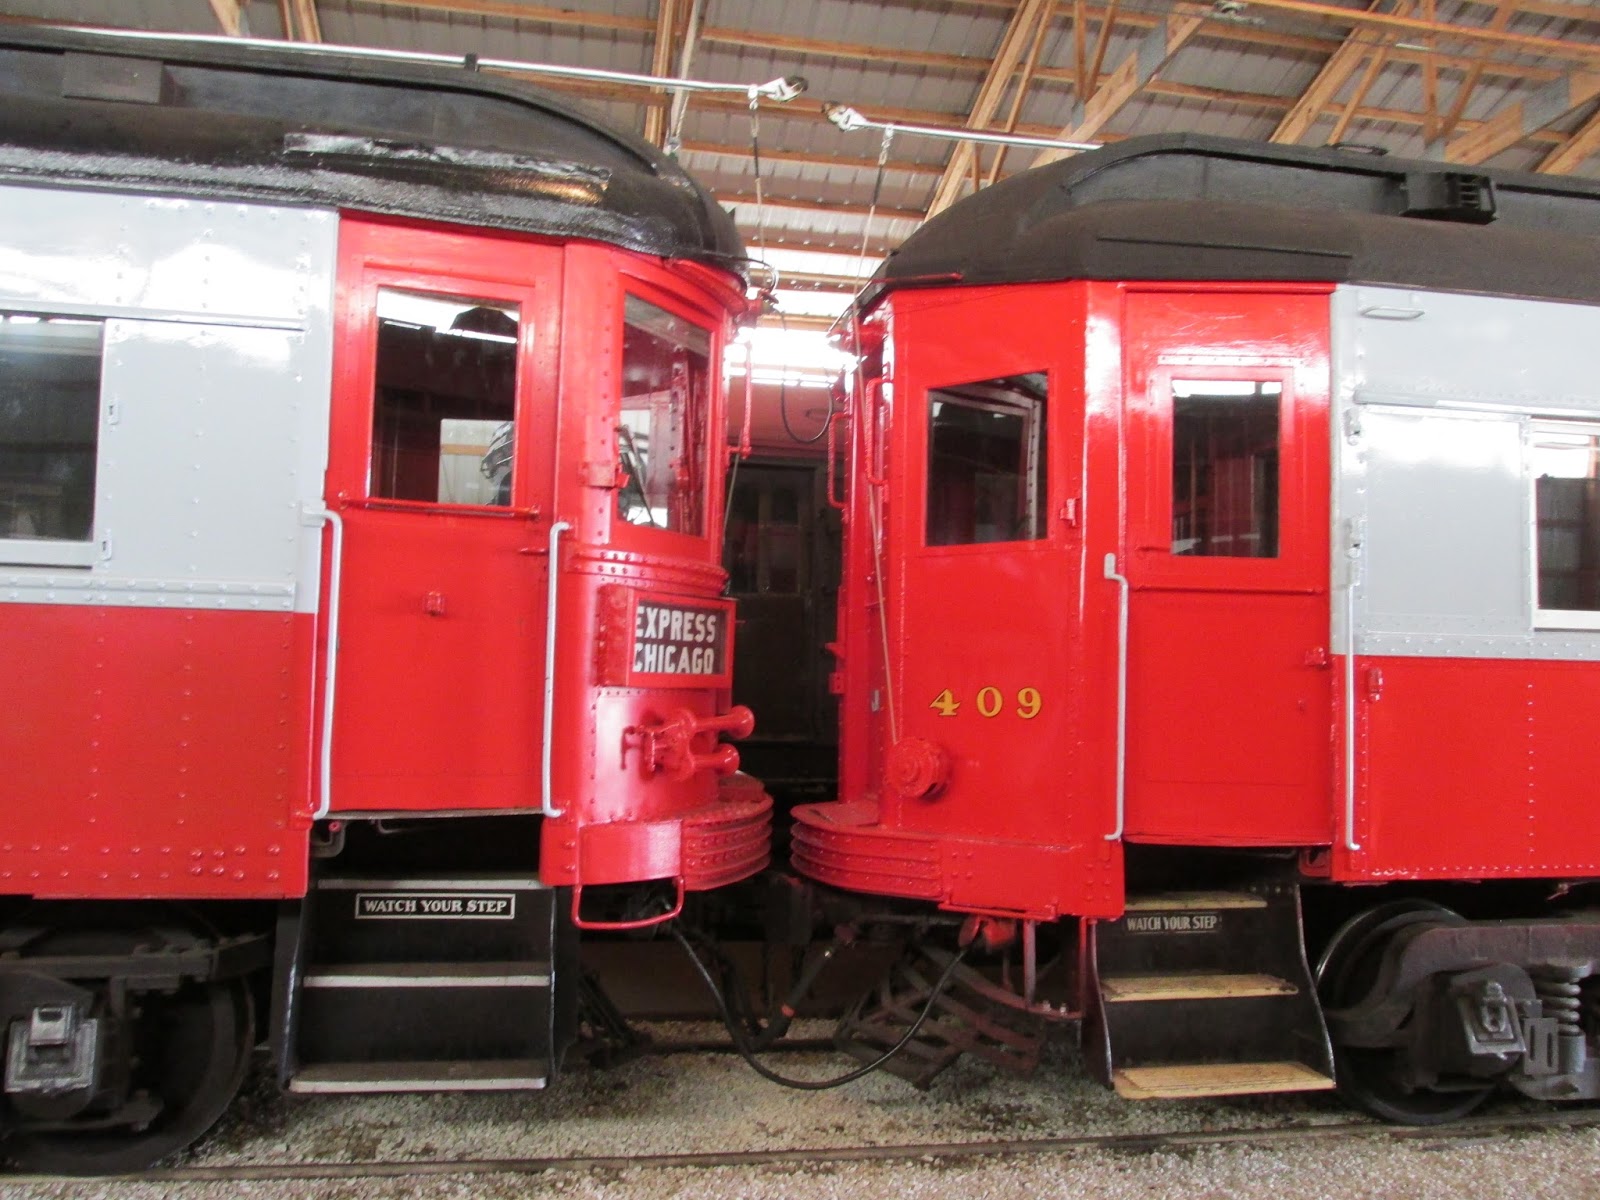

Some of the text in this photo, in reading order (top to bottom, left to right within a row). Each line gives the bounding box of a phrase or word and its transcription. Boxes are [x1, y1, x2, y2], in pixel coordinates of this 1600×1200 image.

[635, 605, 717, 643] EXPRESS
[632, 642, 715, 675] CHICAGO
[928, 686, 1042, 719] 409
[364, 899, 508, 913] WATCH YOUR STEP
[1126, 915, 1218, 931] WATCH YOUR STEP
